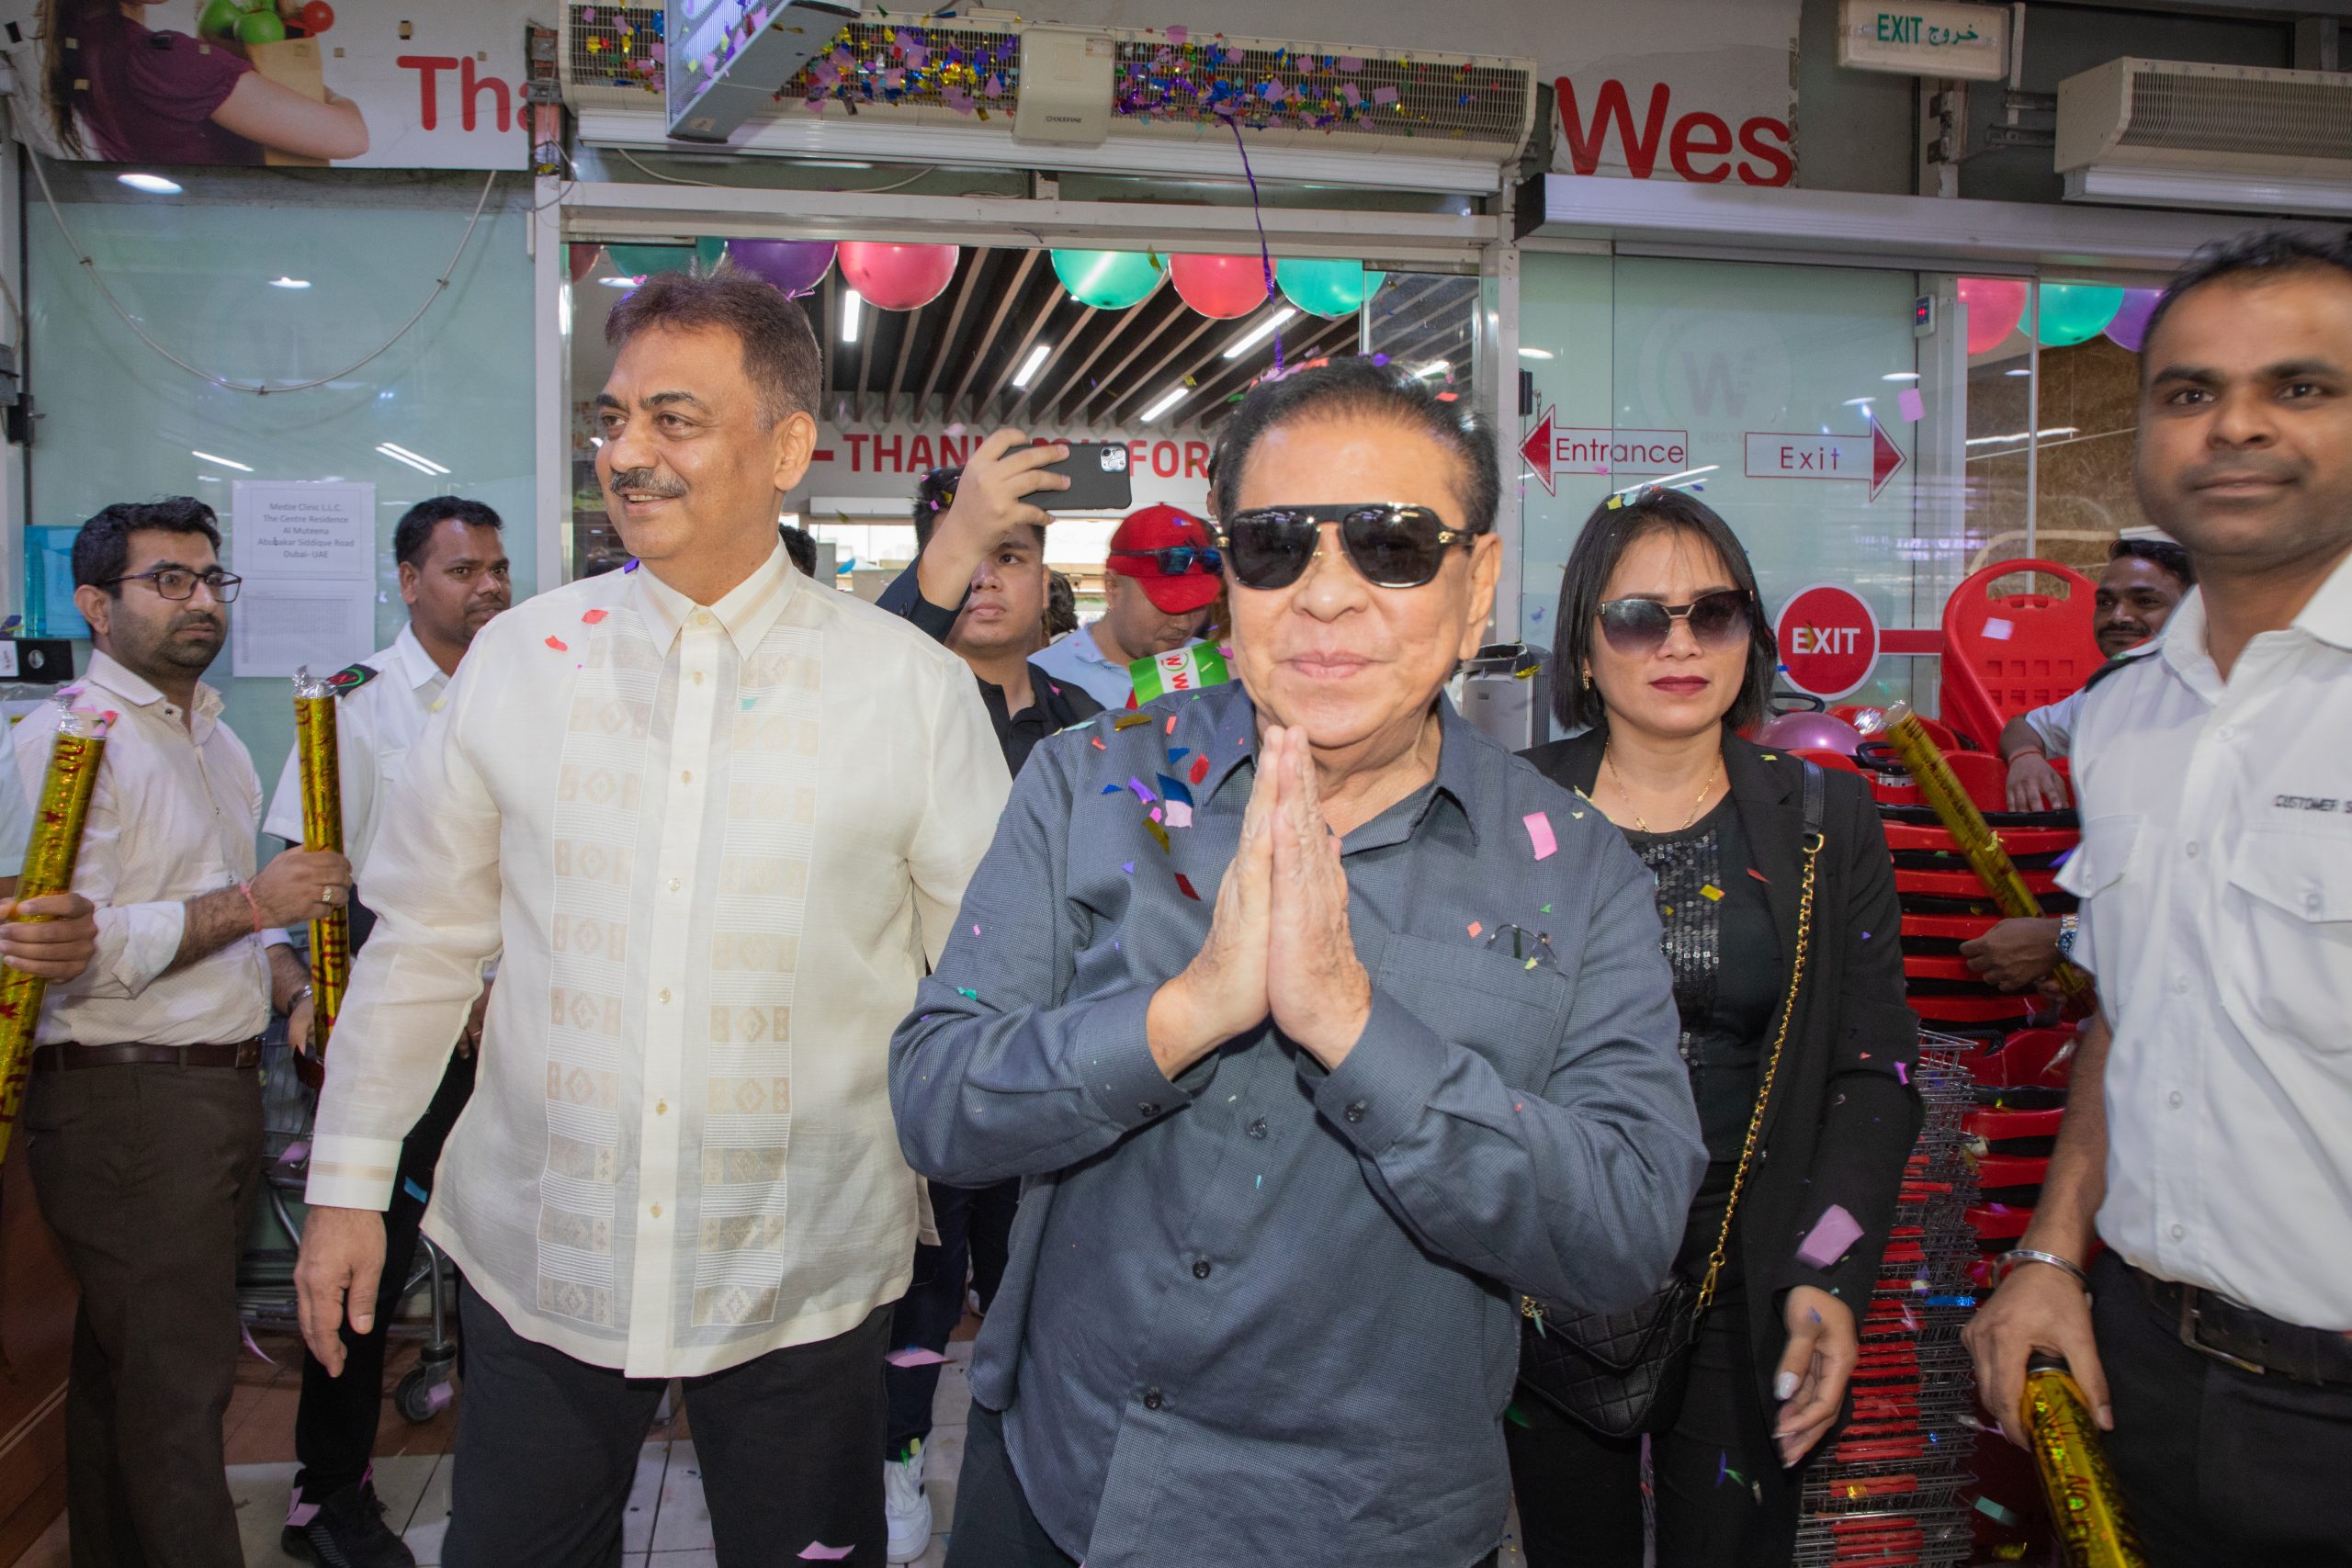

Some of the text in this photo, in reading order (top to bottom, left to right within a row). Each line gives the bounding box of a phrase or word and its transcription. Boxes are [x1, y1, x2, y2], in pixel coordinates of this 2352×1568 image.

[1877, 14, 1923, 44] EXIT
[1929, 24, 1979, 46] خروج
[1555, 75, 1793, 187] Wes
[842, 434, 1210, 479] THAN FOR
[1556, 437, 1684, 463] Entrance
[1780, 446, 1840, 470] Exit
[263, 514, 349, 524] The Centre Residence
[311, 551, 330, 559] UAE
[1792, 626, 1860, 655] EXIT
[2274, 794, 2337, 813] CUSTOMER
